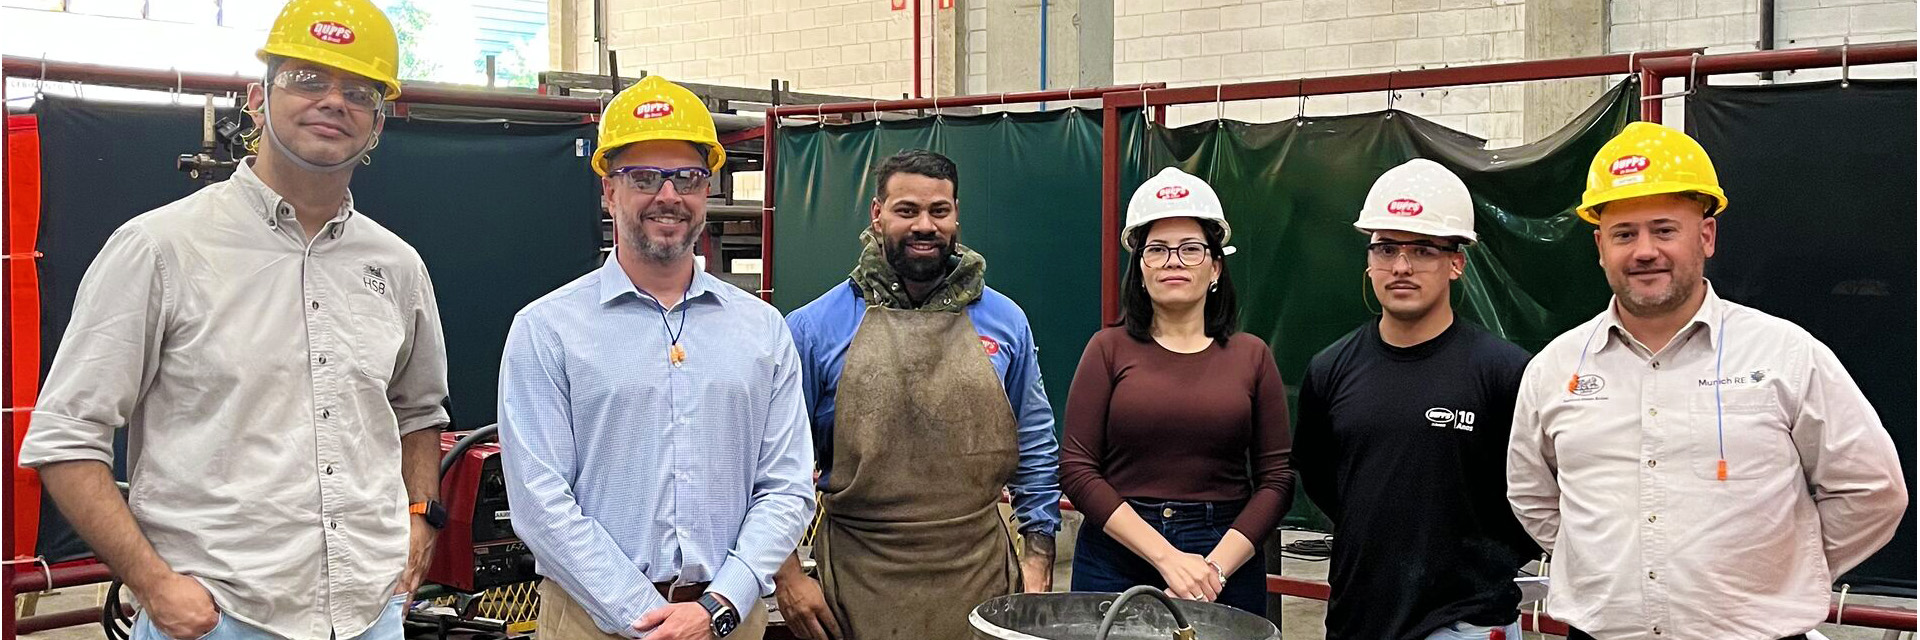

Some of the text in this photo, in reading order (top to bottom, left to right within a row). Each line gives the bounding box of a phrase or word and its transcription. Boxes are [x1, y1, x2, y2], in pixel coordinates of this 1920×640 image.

[362, 276, 386, 295] HSB
[1698, 376, 1746, 387] Munich RE
[1458, 410, 1475, 425] 10
